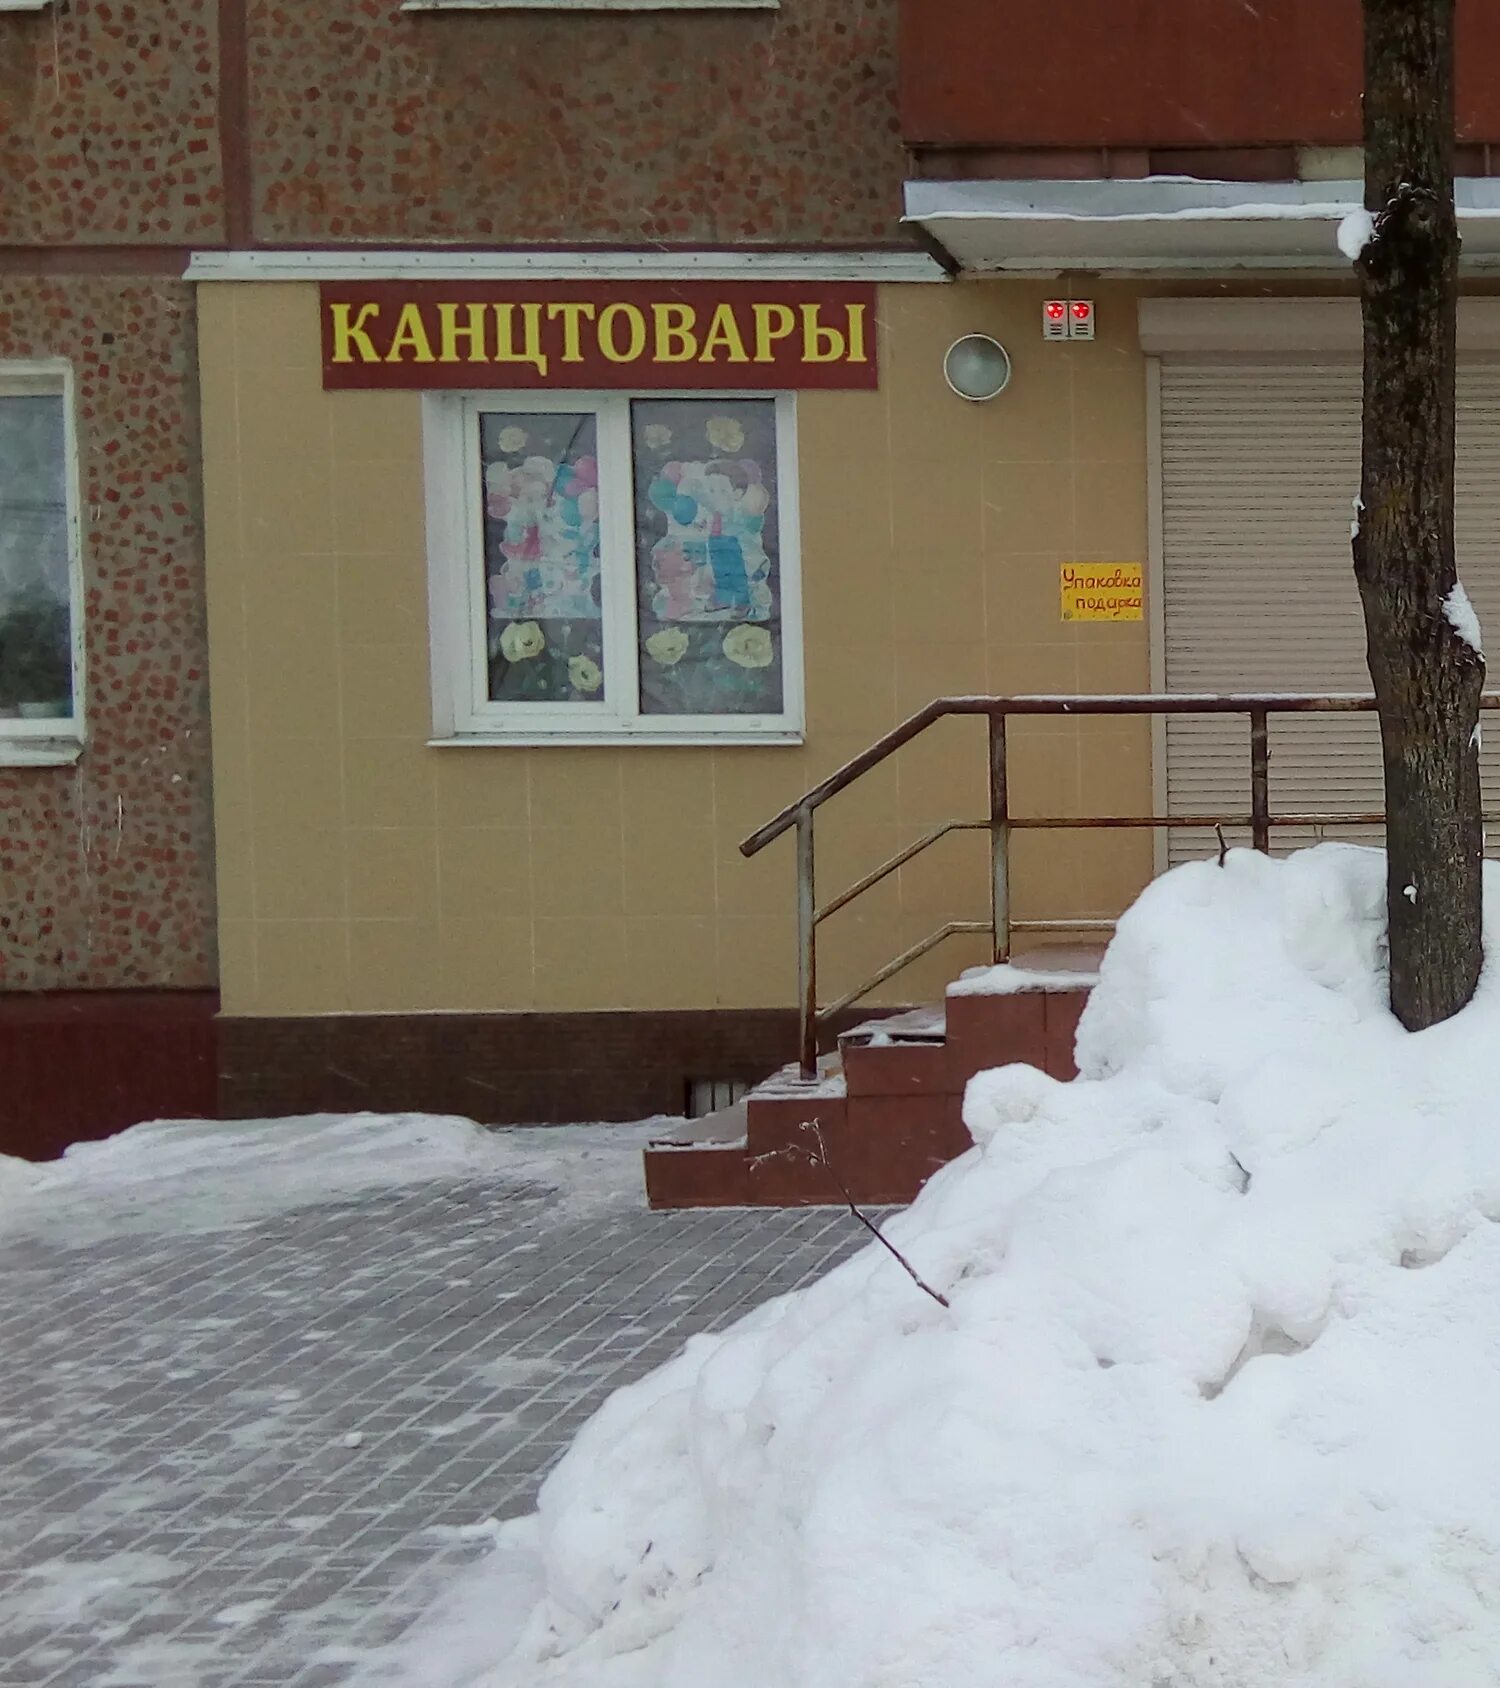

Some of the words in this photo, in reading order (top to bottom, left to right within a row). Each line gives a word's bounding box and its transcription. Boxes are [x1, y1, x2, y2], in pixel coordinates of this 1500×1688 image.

[330, 302, 868, 376] КАНЦТОВАРЫ
[1063, 568, 1141, 591] Упаковка
[1075, 598, 1142, 617] подарка
